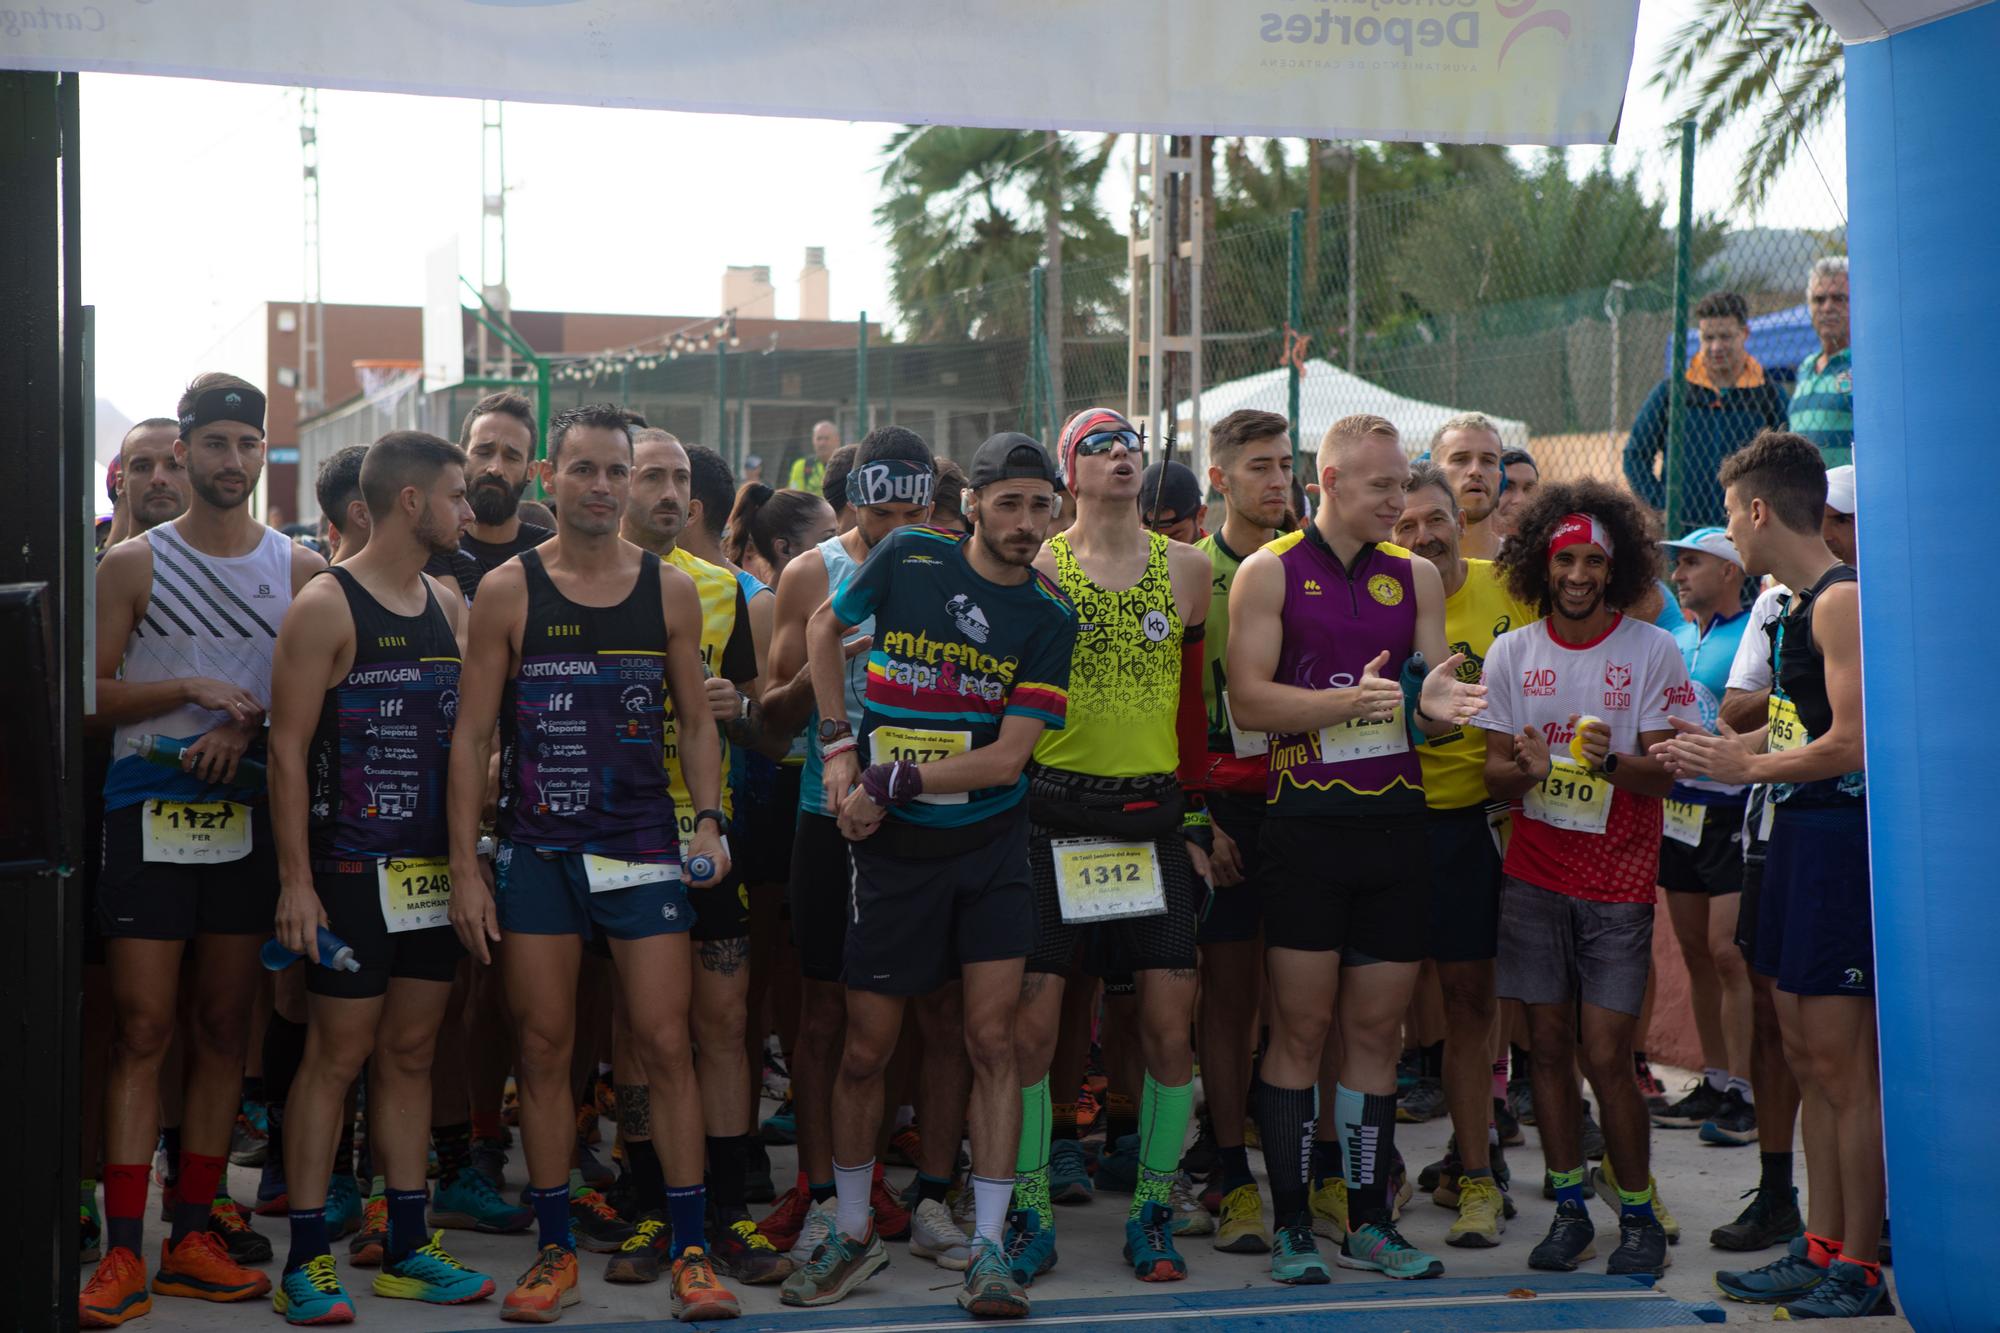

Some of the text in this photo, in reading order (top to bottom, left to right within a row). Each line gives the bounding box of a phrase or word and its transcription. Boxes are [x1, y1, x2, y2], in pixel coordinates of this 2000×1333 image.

[883, 628, 1019, 686] entrenos
[348, 668, 422, 685] CARTAGENA
[522, 661, 597, 677] CARTAGENA
[620, 671, 662, 680] DE TESOR
[1523, 667, 1557, 688] ZAID
[548, 692, 573, 711] iff
[1604, 692, 1631, 707] OTSO
[1661, 683, 1697, 711] Jimb
[379, 698, 404, 717] iff
[381, 729, 419, 737] Deportes
[548, 725, 587, 733] Deportes
[1543, 721, 1576, 746] Jim
[1269, 739, 1309, 772] Torre
[1541, 778, 1593, 802] 1310
[167, 811, 230, 829] 1127
[1079, 863, 1141, 885] 1312
[402, 874, 450, 896] 1248
[407, 899, 450, 910] MARCHANT
